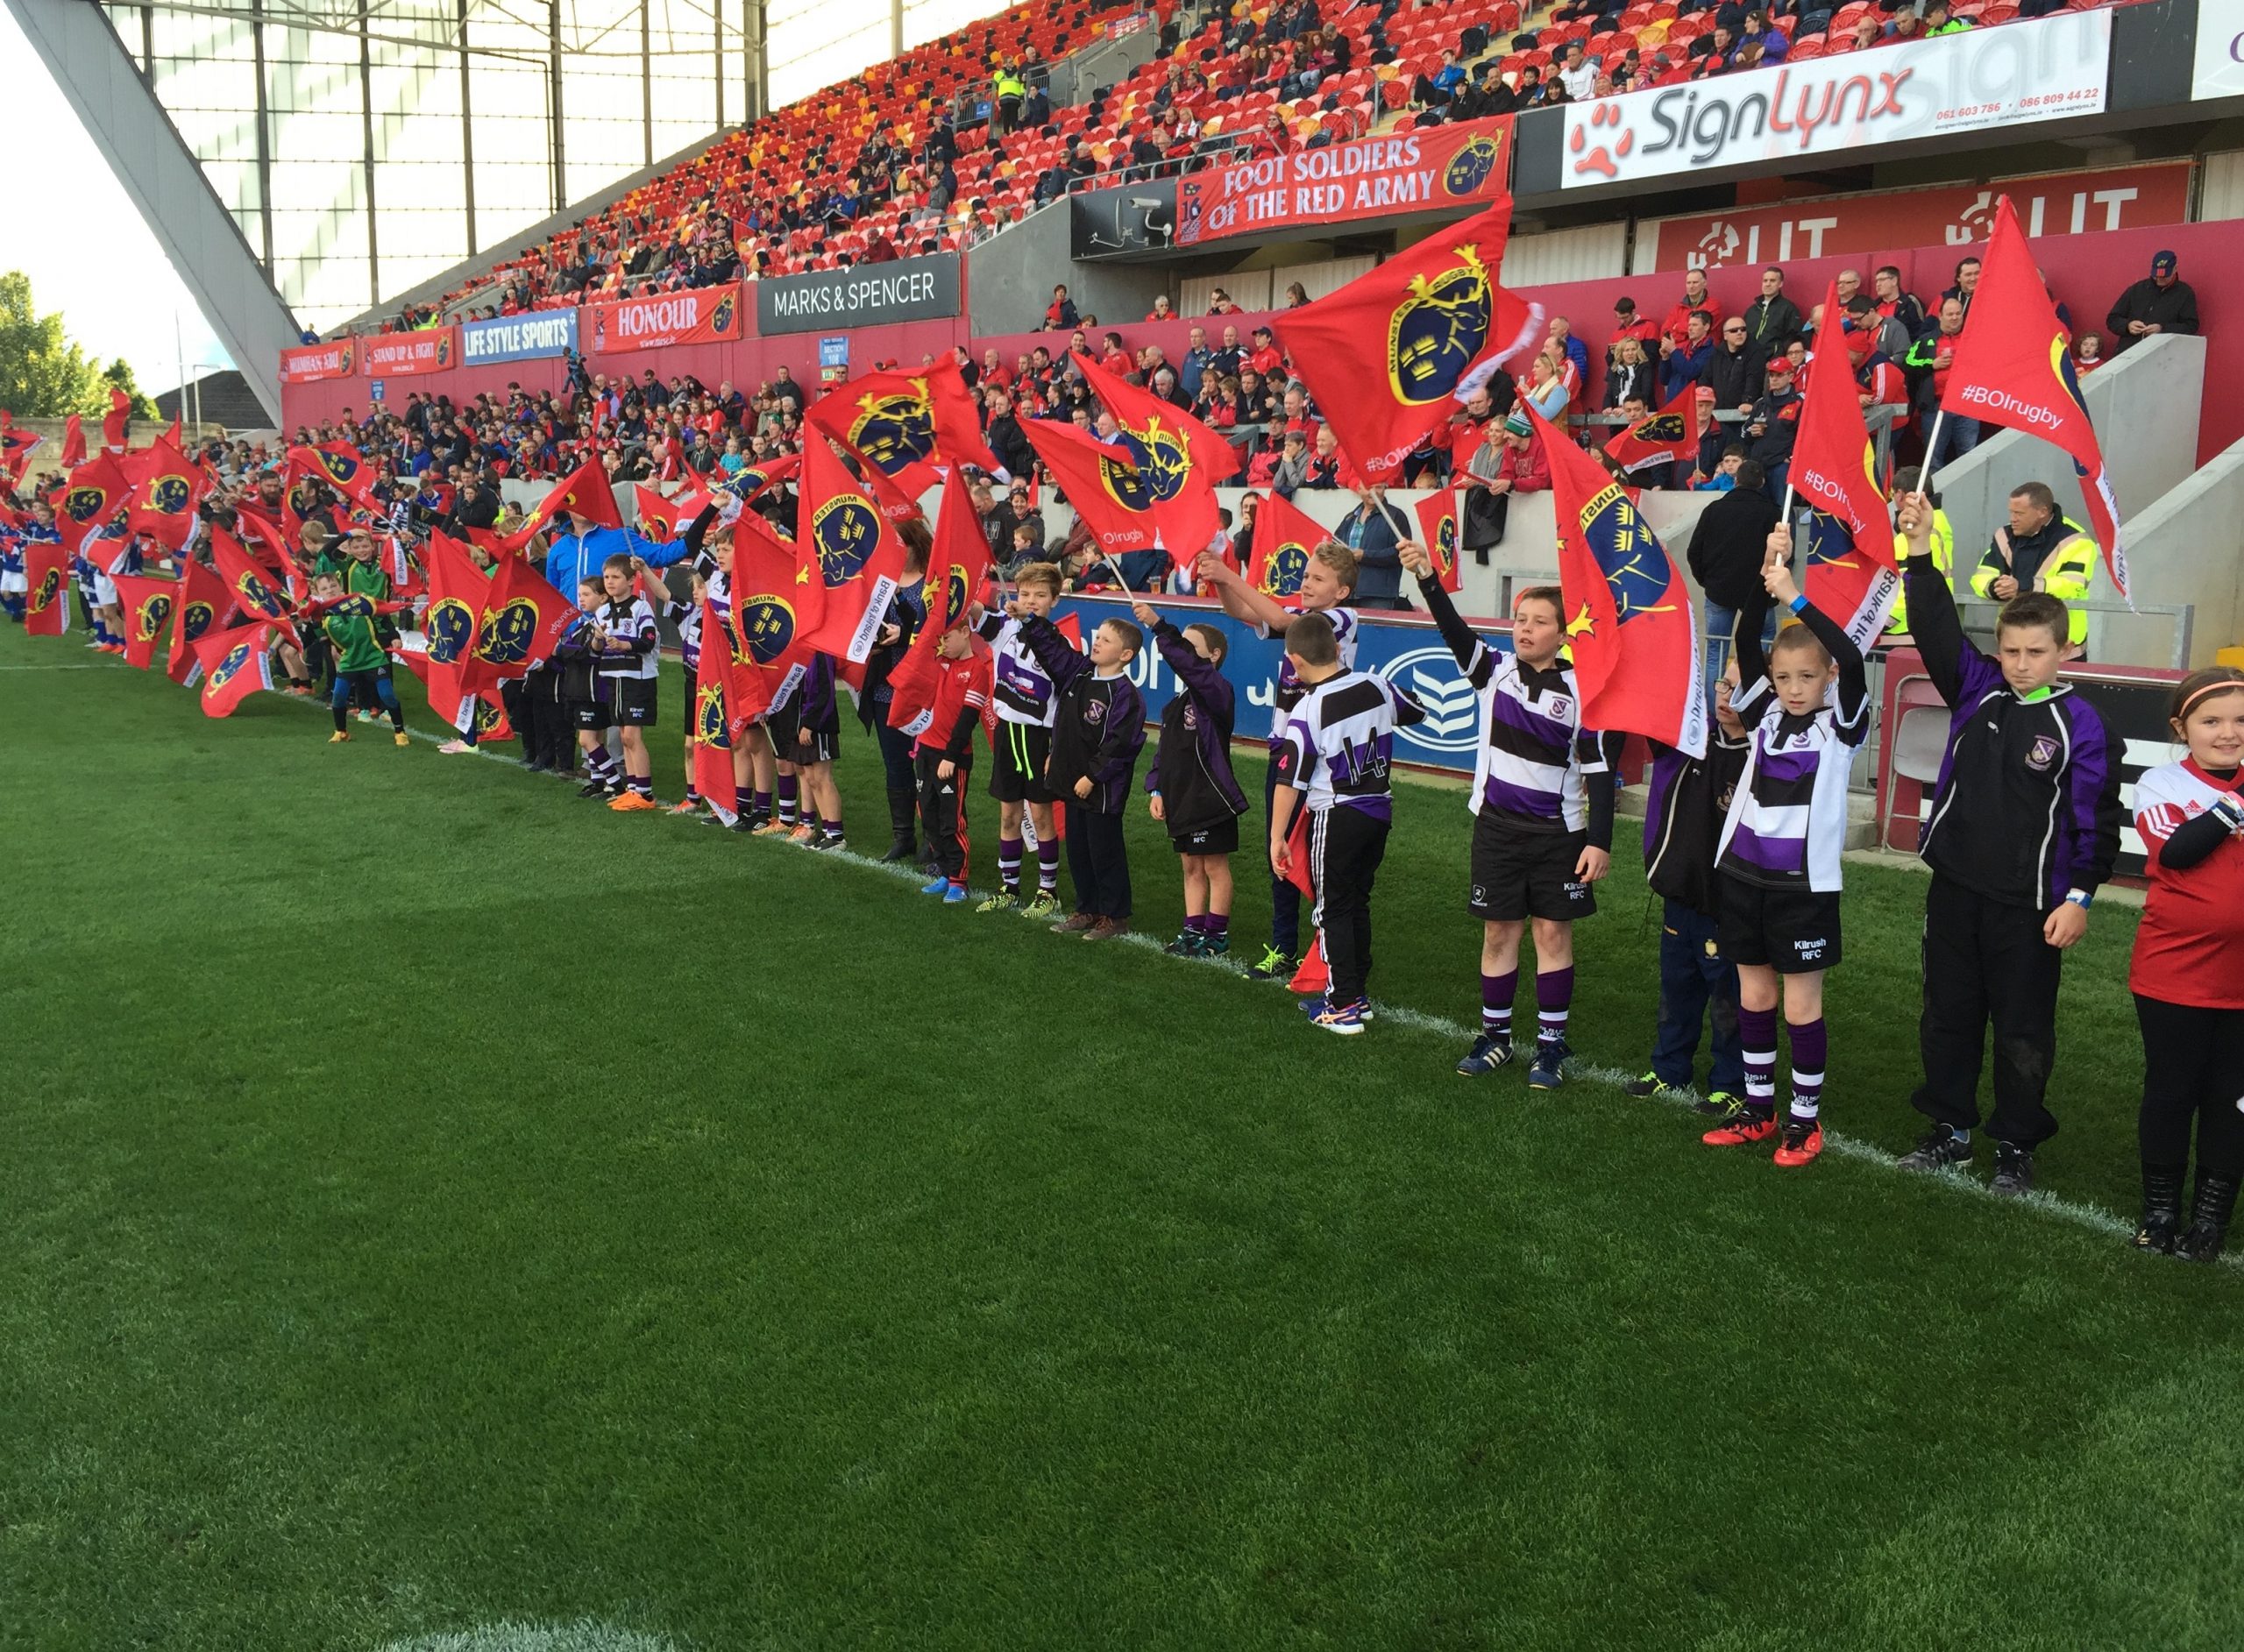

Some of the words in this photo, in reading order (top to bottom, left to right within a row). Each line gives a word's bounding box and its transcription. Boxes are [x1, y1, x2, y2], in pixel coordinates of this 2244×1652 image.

[1642, 68, 1914, 164] SignLynx
[1936, 109, 1956, 121] 061
[1958, 106, 1978, 117] 603
[1981, 103, 2001, 114] 786
[2020, 97, 2040, 109] 086
[2042, 93, 2064, 106] 809
[2067, 90, 2081, 101] 44
[2084, 88, 2098, 99] 22
[1225, 156, 1288, 198] FOOT
[1293, 136, 1422, 182] SOLDIERS
[1246, 188, 1289, 223] THE
[1296, 184, 1346, 215] RED
[1353, 170, 1437, 210] ARMY
[774, 287, 831, 317] MARKS
[834, 286, 845, 311] &
[847, 272, 935, 310] SPENCER
[1433, 266, 1474, 291] RUGBY
[618, 295, 698, 338] HONOUR
[373, 346, 395, 364] STAND
[396, 344, 406, 362] UP
[415, 342, 435, 358] FIGHT
[465, 328, 485, 357] LIFE
[486, 323, 520, 354] STYLE
[522, 317, 568, 350] SPORTS
[1388, 301, 1414, 373] MUNSTER
[1961, 384, 2064, 430] #BOIrugby
[1277, 754, 1289, 770] 4
[1342, 726, 1388, 786] 14
[1569, 890, 1585, 900] RFC
[1793, 937, 1827, 950] Kilrush
[1801, 949, 1822, 961] RFC
